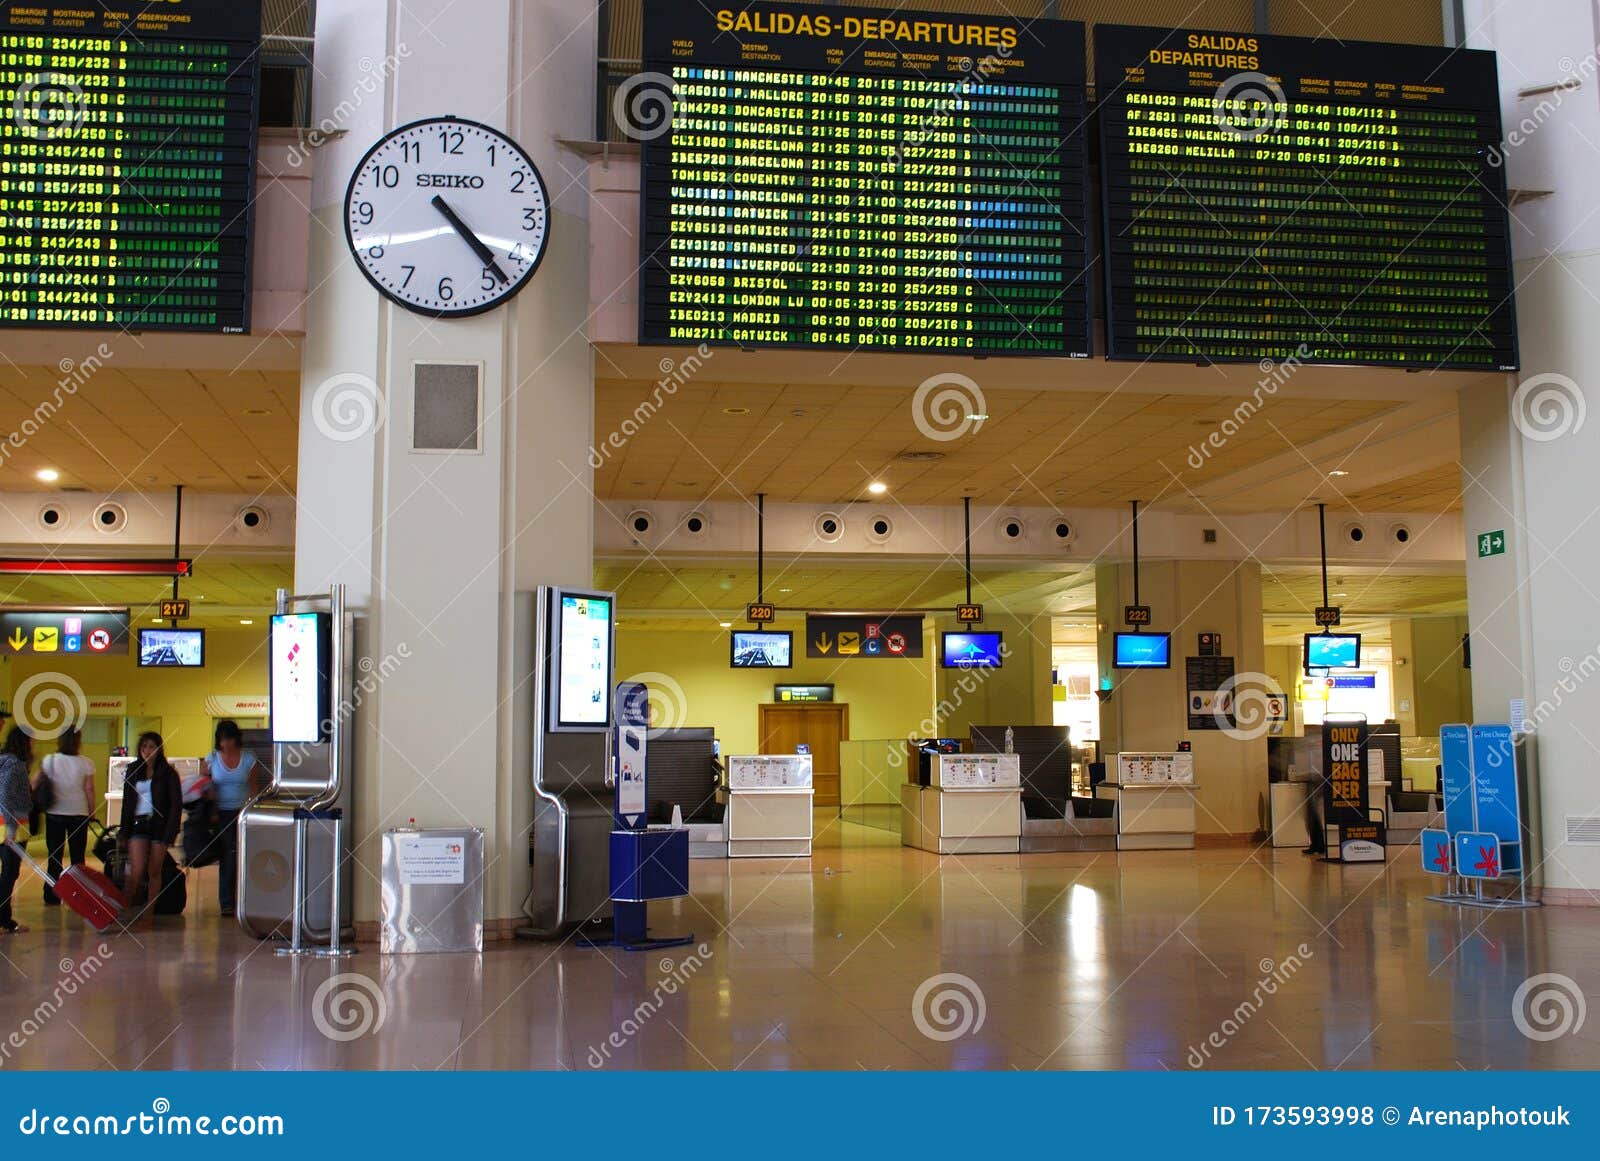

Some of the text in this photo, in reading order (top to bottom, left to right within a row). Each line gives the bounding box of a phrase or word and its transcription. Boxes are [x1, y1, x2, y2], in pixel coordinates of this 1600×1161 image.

[53, 10, 95, 18] MOSTRADOR
[53, 18, 85, 26] COUNTER
[716, 9, 1017, 48] SALIDAS-DEPARTURES
[672, 40, 694, 48] VUELO
[1188, 34, 1258, 52] SALIDAS
[672, 48, 694, 56] FLIGHT
[826, 57, 842, 65] TIME
[1150, 50, 1259, 70] DEPARTURES
[812, 76, 849, 87] 20:45
[858, 78, 894, 89] 20:15
[812, 93, 849, 104] 20:50
[858, 95, 895, 106] 20:25
[1127, 94, 1328, 114] AEA1033 PARIS/CDG 07:05 06:40
[735, 106, 803, 118] DONCASTER
[812, 110, 849, 121] 21:15
[1127, 110, 1329, 131] AF 2631 PARIS/CDG 07:05 06:40
[735, 122, 803, 135] NEWCASTLE
[812, 127, 849, 137] 21:25
[439, 132, 464, 154] 12
[735, 139, 849, 154] BARCELONA 21:25
[1186, 130, 1241, 141] VALENCIA
[1256, 134, 1289, 144] 07:10
[1298, 137, 1329, 147] 06:41
[1338, 139, 1385, 149] 209/216
[400, 142, 420, 164] 11
[487, 145, 496, 167] 1
[1186, 147, 1234, 157] MELILLA
[1257, 151, 1290, 161] 07:20
[1298, 153, 1330, 163] 06:51
[1339, 155, 1385, 166] 209/216
[735, 156, 849, 170] BARCELONA 21:25
[372, 165, 399, 188] 10
[416, 174, 484, 189] SEIKO
[510, 170, 524, 194] 2
[735, 173, 795, 185] COVENTRY
[812, 177, 849, 188] 21:30
[858, 179, 893, 190] 21:01
[735, 190, 803, 203] BARCELONA
[812, 194, 849, 205] 21:30
[859, 196, 895, 207] 21:00
[359, 202, 374, 224] 9
[522, 208, 536, 231] 3
[734, 208, 787, 219] GATWICK
[734, 225, 896, 240] GATWICK 22:10 21:40
[508, 242, 524, 265] 4
[734, 242, 795, 254] STANSTED
[812, 245, 849, 256] 22:10
[734, 260, 896, 275] LIVERPOOL 22:30 22:00
[40, 273, 97, 285] 244/244
[400, 266, 416, 288] 7
[480, 267, 496, 290] 5
[734, 277, 896, 293] BRISTOL 23:50 23:20
[438, 278, 453, 300] 6
[670, 292, 896, 310] EZY2412 LONDON LU 00:05 23:35
[670, 310, 896, 327] IBE0213 MADRID 06:30 06:00
[670, 328, 724, 339] BAW2711
[734, 330, 787, 341] GATWICK
[812, 333, 850, 343] 06:45
[164, 603, 185, 615] 217
[751, 607, 770, 618] 220
[960, 608, 979, 619] 221
[1128, 610, 1148, 620] 222
[1320, 611, 1337, 620] 223
[868, 626, 876, 636] B
[68, 637, 76, 650] C
[868, 641, 876, 652] C
[1331, 728, 1358, 742] ONLY
[1331, 744, 1360, 762] ONE
[1332, 762, 1360, 780] BAG
[1332, 781, 1360, 798] PER
